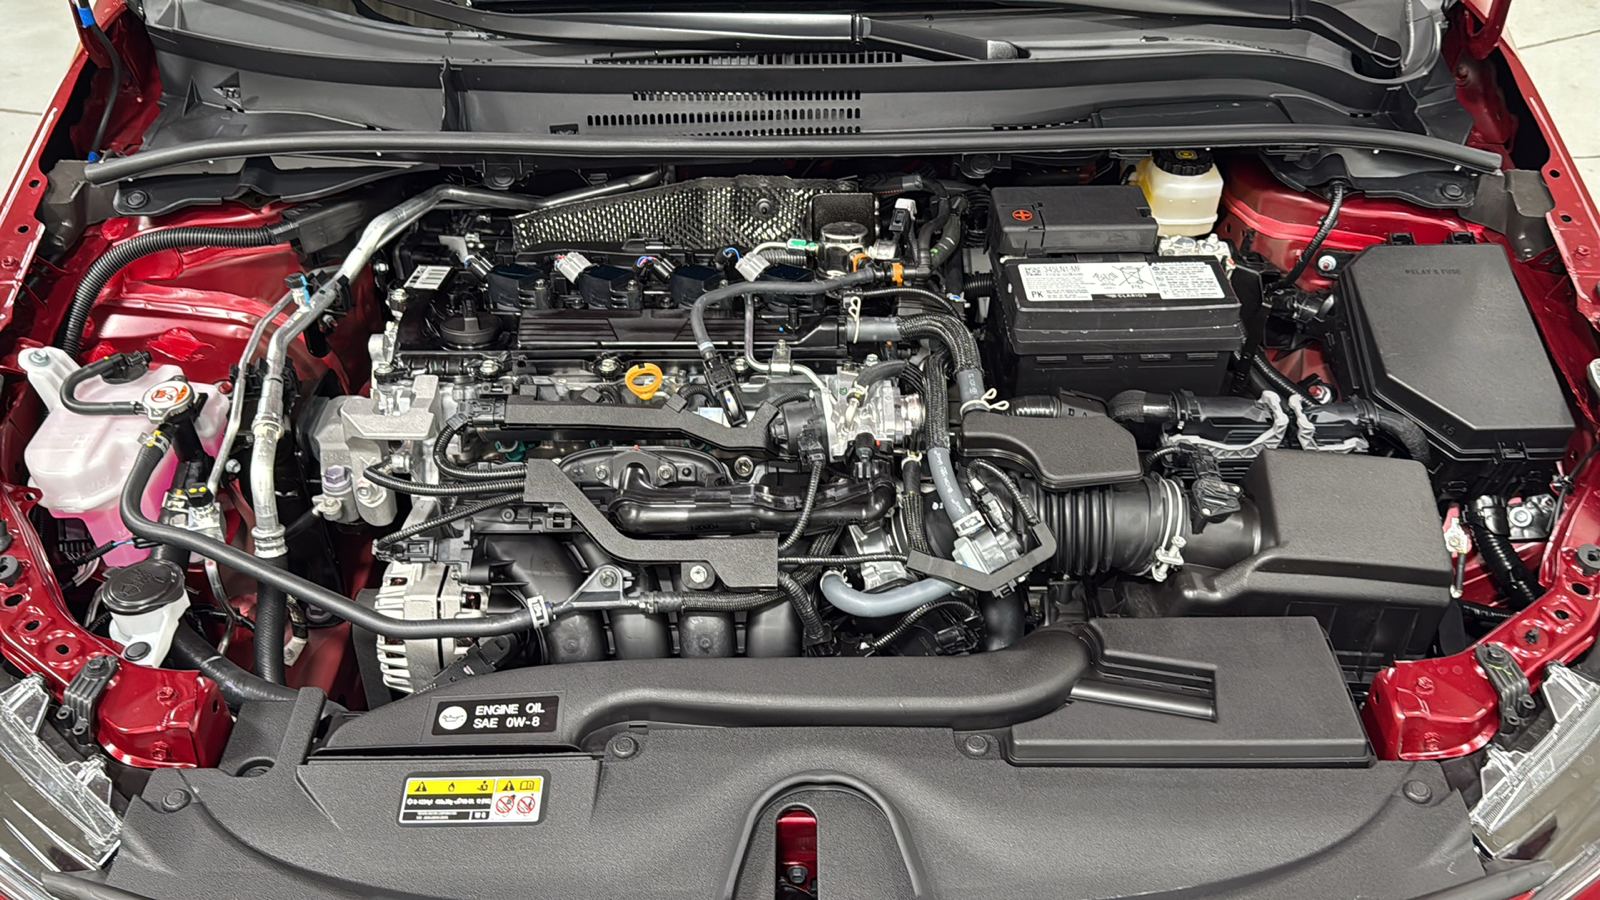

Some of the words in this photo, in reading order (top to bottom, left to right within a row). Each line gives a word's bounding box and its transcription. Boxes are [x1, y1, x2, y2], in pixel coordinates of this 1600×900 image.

[1031, 290, 1044, 298] PK
[475, 703, 519, 715] ENGINE
[525, 702, 545, 714] OIL
[473, 718, 498, 729] SAE
[505, 716, 540, 728] 0W-8
